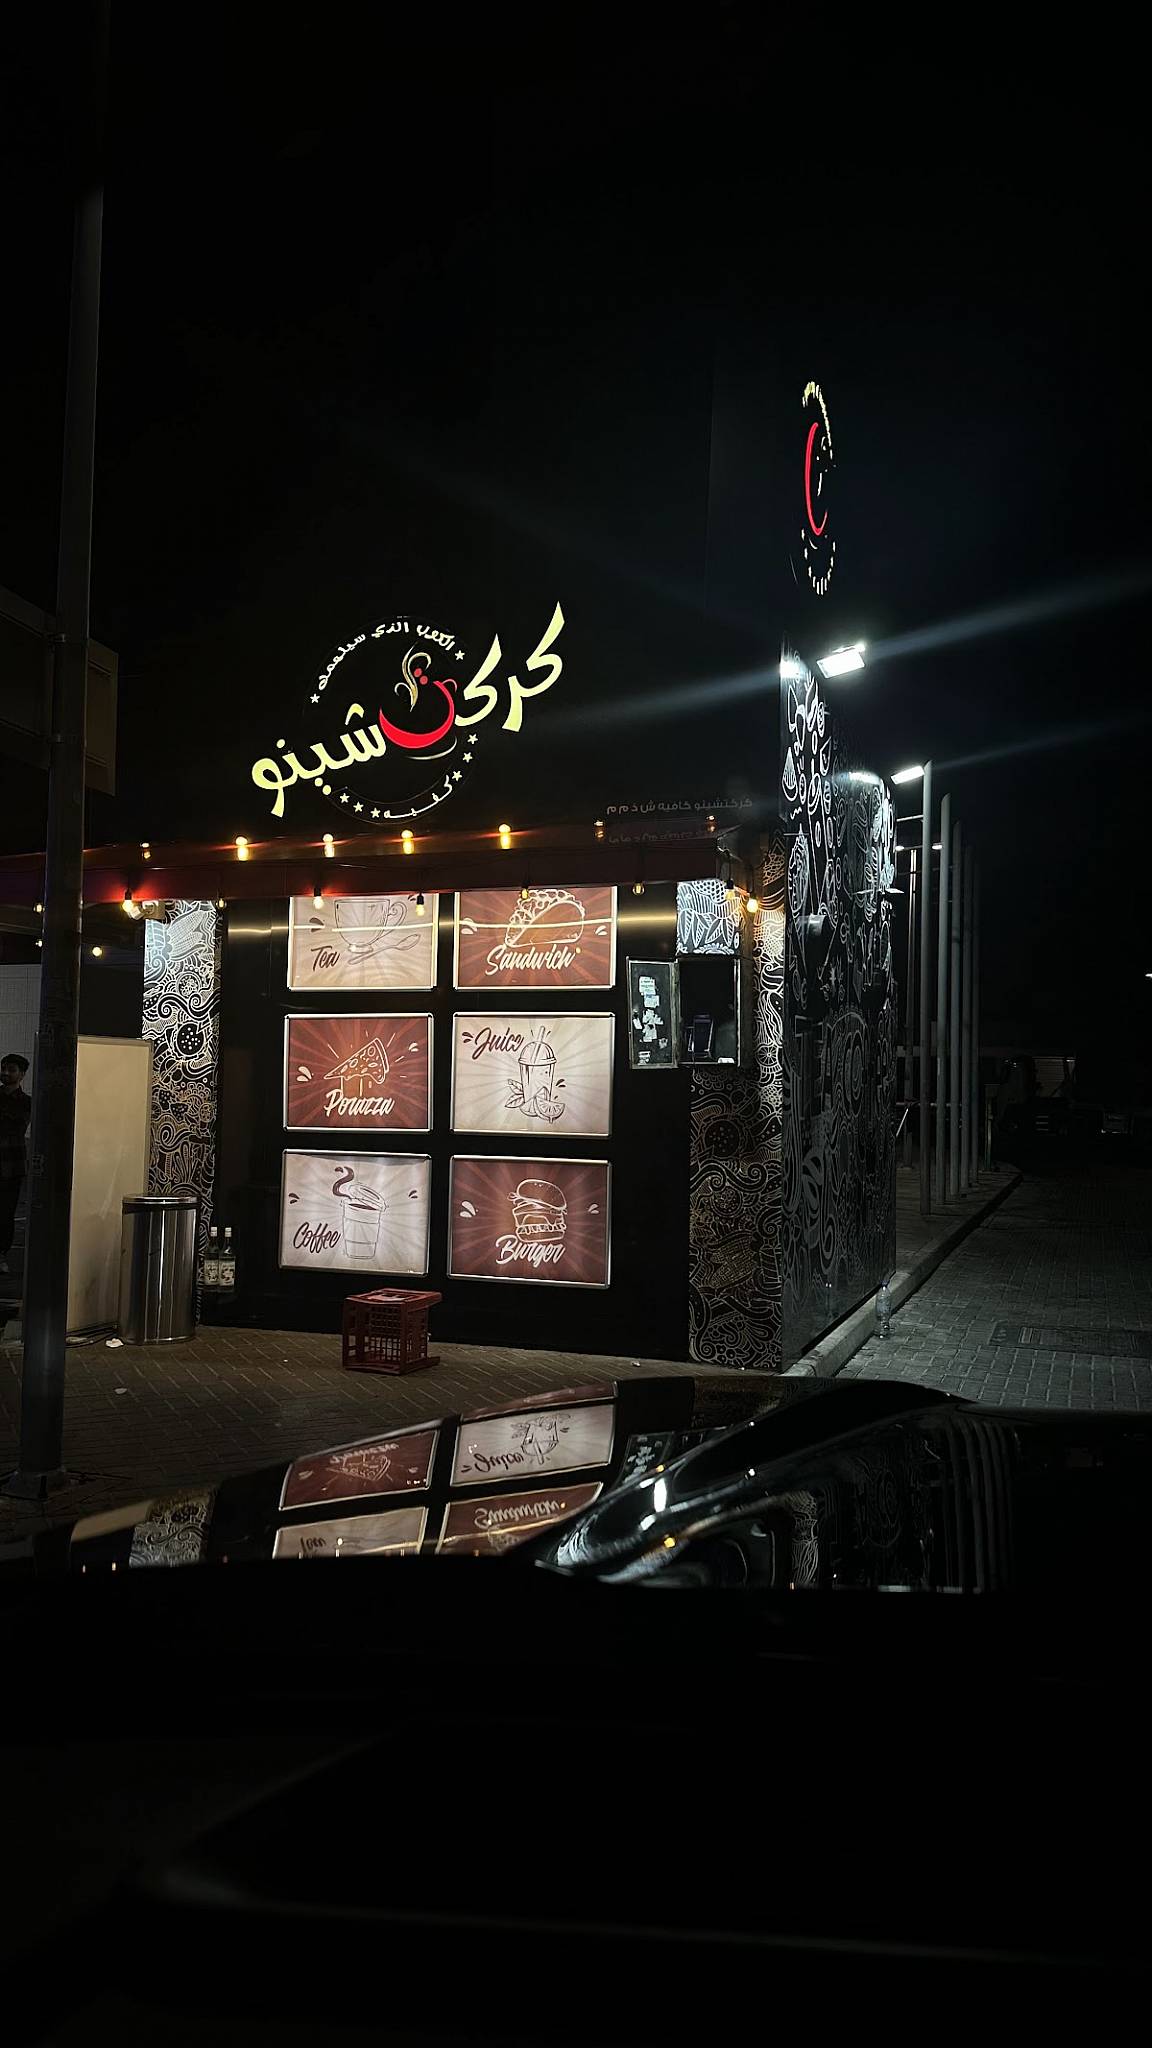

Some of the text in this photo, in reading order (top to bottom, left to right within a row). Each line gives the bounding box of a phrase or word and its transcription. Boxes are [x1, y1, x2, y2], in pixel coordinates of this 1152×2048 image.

[310, 945, 341, 972] Tea
[485, 943, 576, 976] Sandwich
[472, 1027, 525, 1061] Juice
[293, 1221, 342, 1254] Coffee
[495, 1234, 567, 1269] Burger
